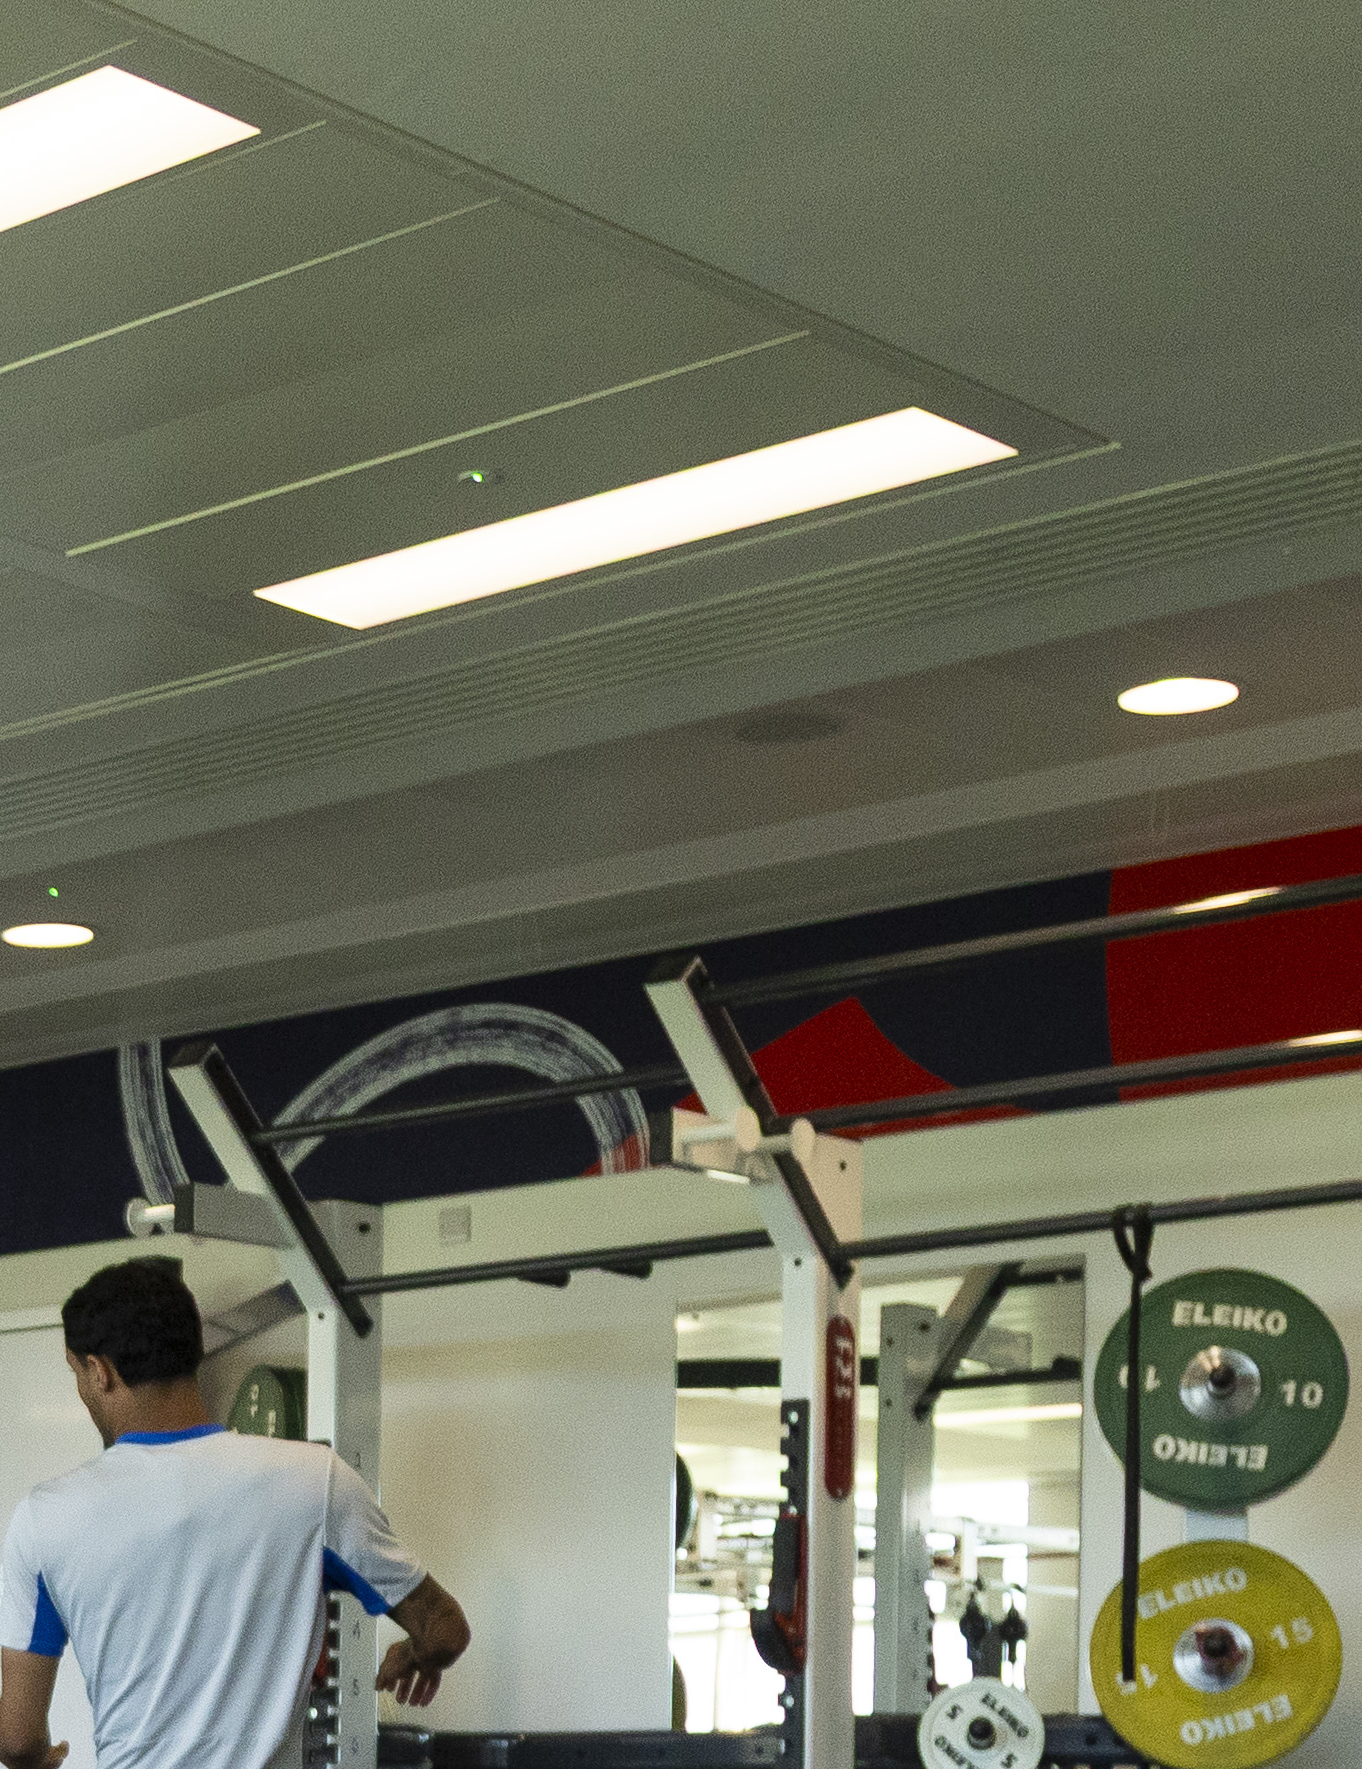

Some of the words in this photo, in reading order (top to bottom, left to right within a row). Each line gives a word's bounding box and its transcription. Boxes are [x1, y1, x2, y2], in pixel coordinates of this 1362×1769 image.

[1172, 1300, 1288, 1337] ELEIKO
[1281, 1380, 1324, 1409] 10
[1153, 1433, 1268, 1471] ELEIKO
[1137, 1567, 1249, 1620] ELEIKO
[1271, 1616, 1315, 1650] 15
[980, 1692, 1030, 1739] ELEIKO
[1180, 1694, 1293, 1746] ELEIKO
